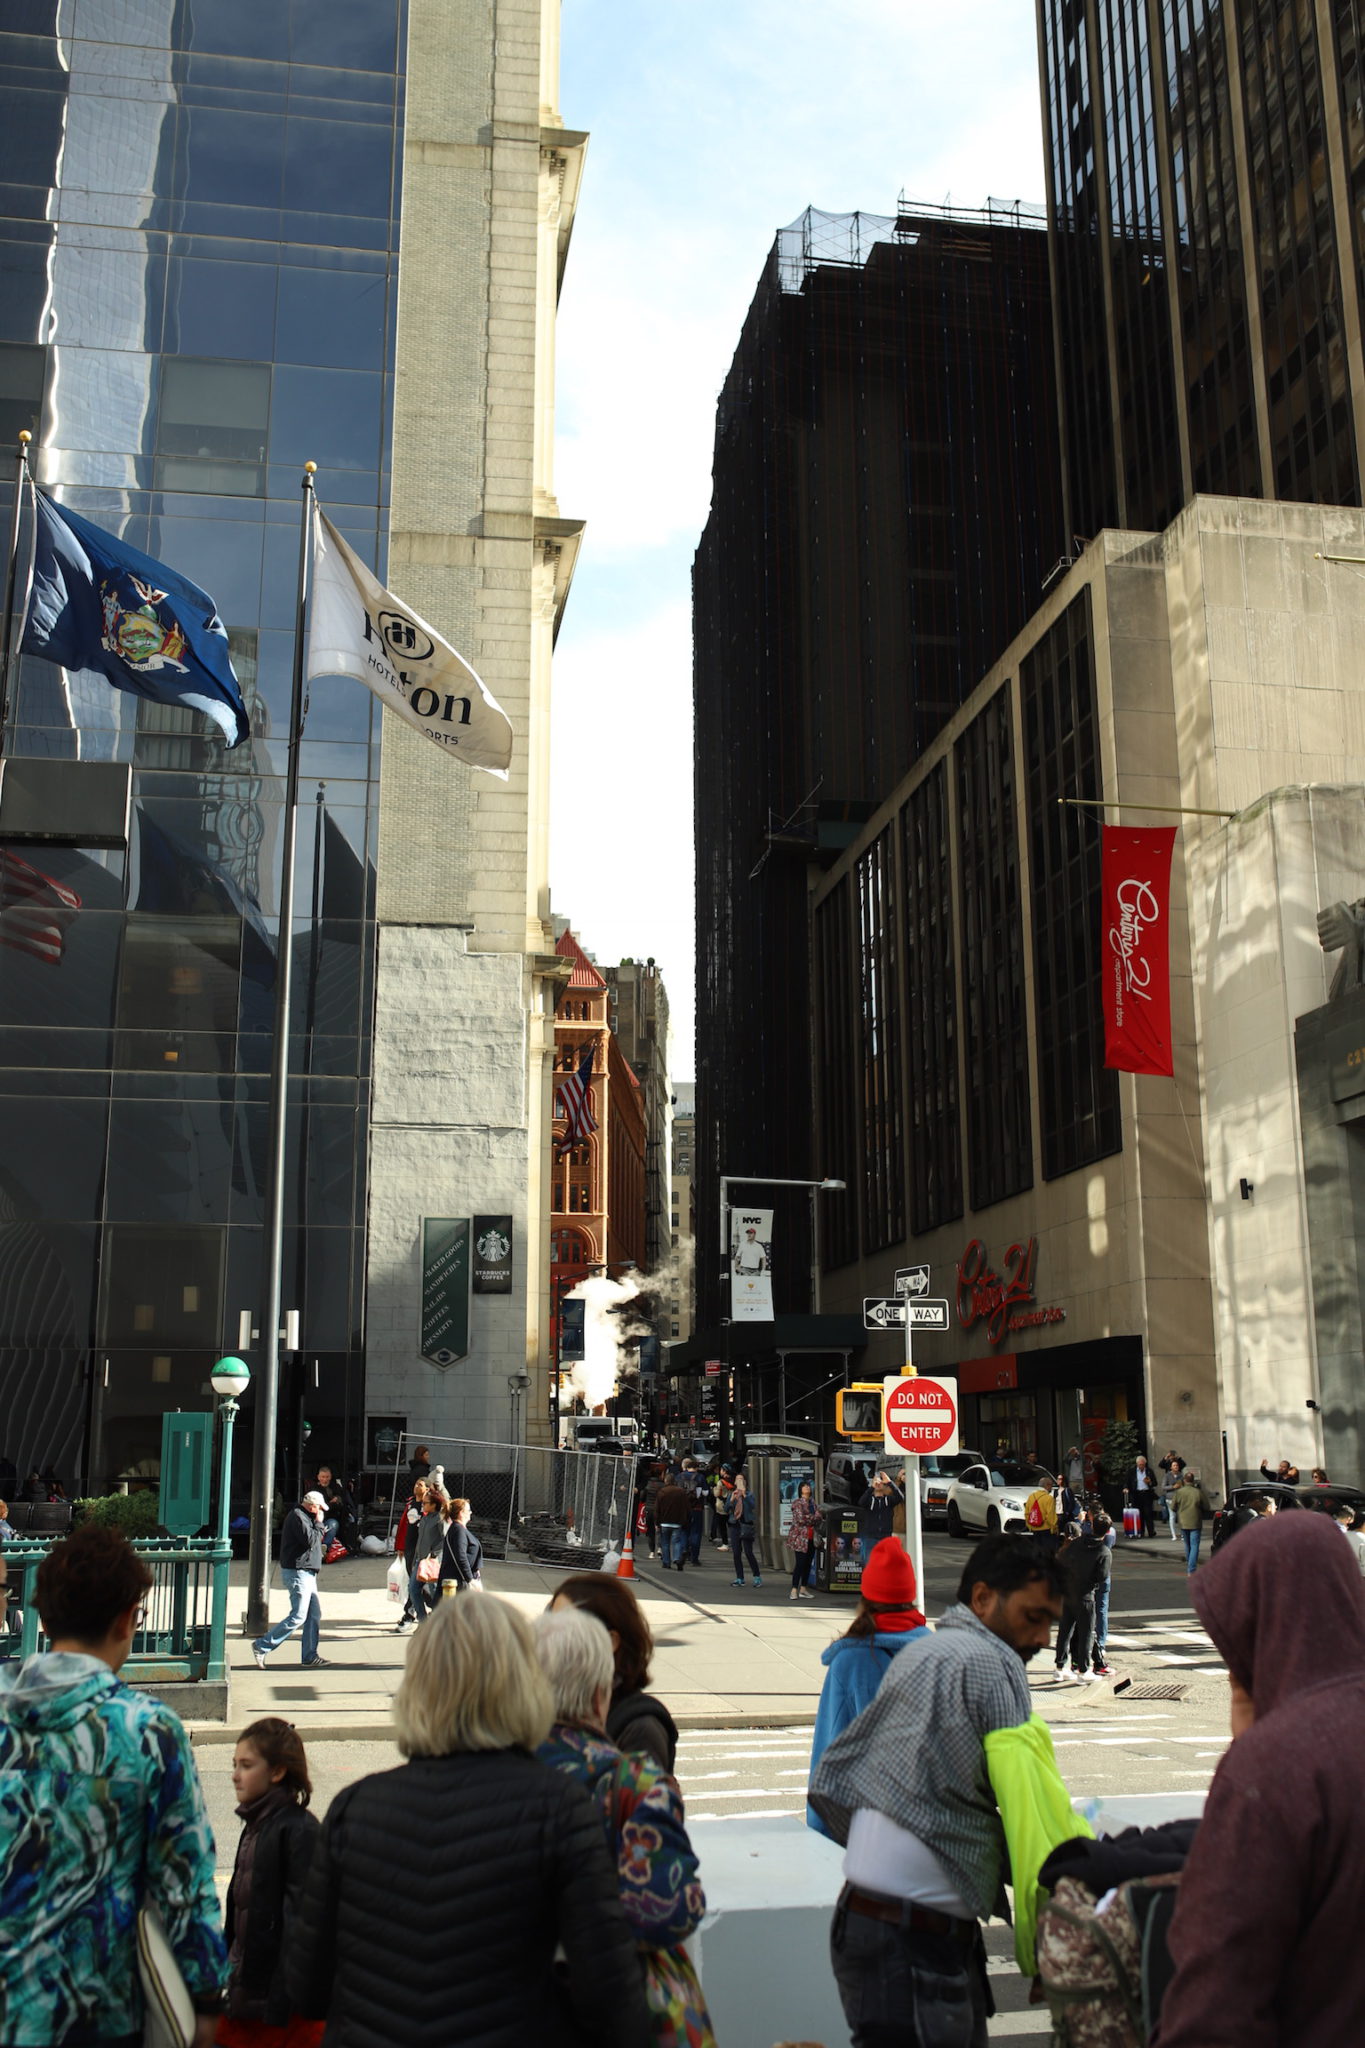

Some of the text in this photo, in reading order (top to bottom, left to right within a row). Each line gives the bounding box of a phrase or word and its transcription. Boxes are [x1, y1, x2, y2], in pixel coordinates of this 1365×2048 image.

[368, 654, 406, 697] HOTELS
[1109, 879, 1158, 1001] Century 21
[742, 1217, 762, 1225] NYC
[427, 1239, 464, 1277] BAKED GOODS
[1004, 1236, 1037, 1292] 21
[897, 1275, 924, 1291] ONE WAY
[876, 1308, 940, 1320] ONE WAY
[897, 1393, 943, 1406] DO NOT
[901, 1427, 941, 1439] ENTER
